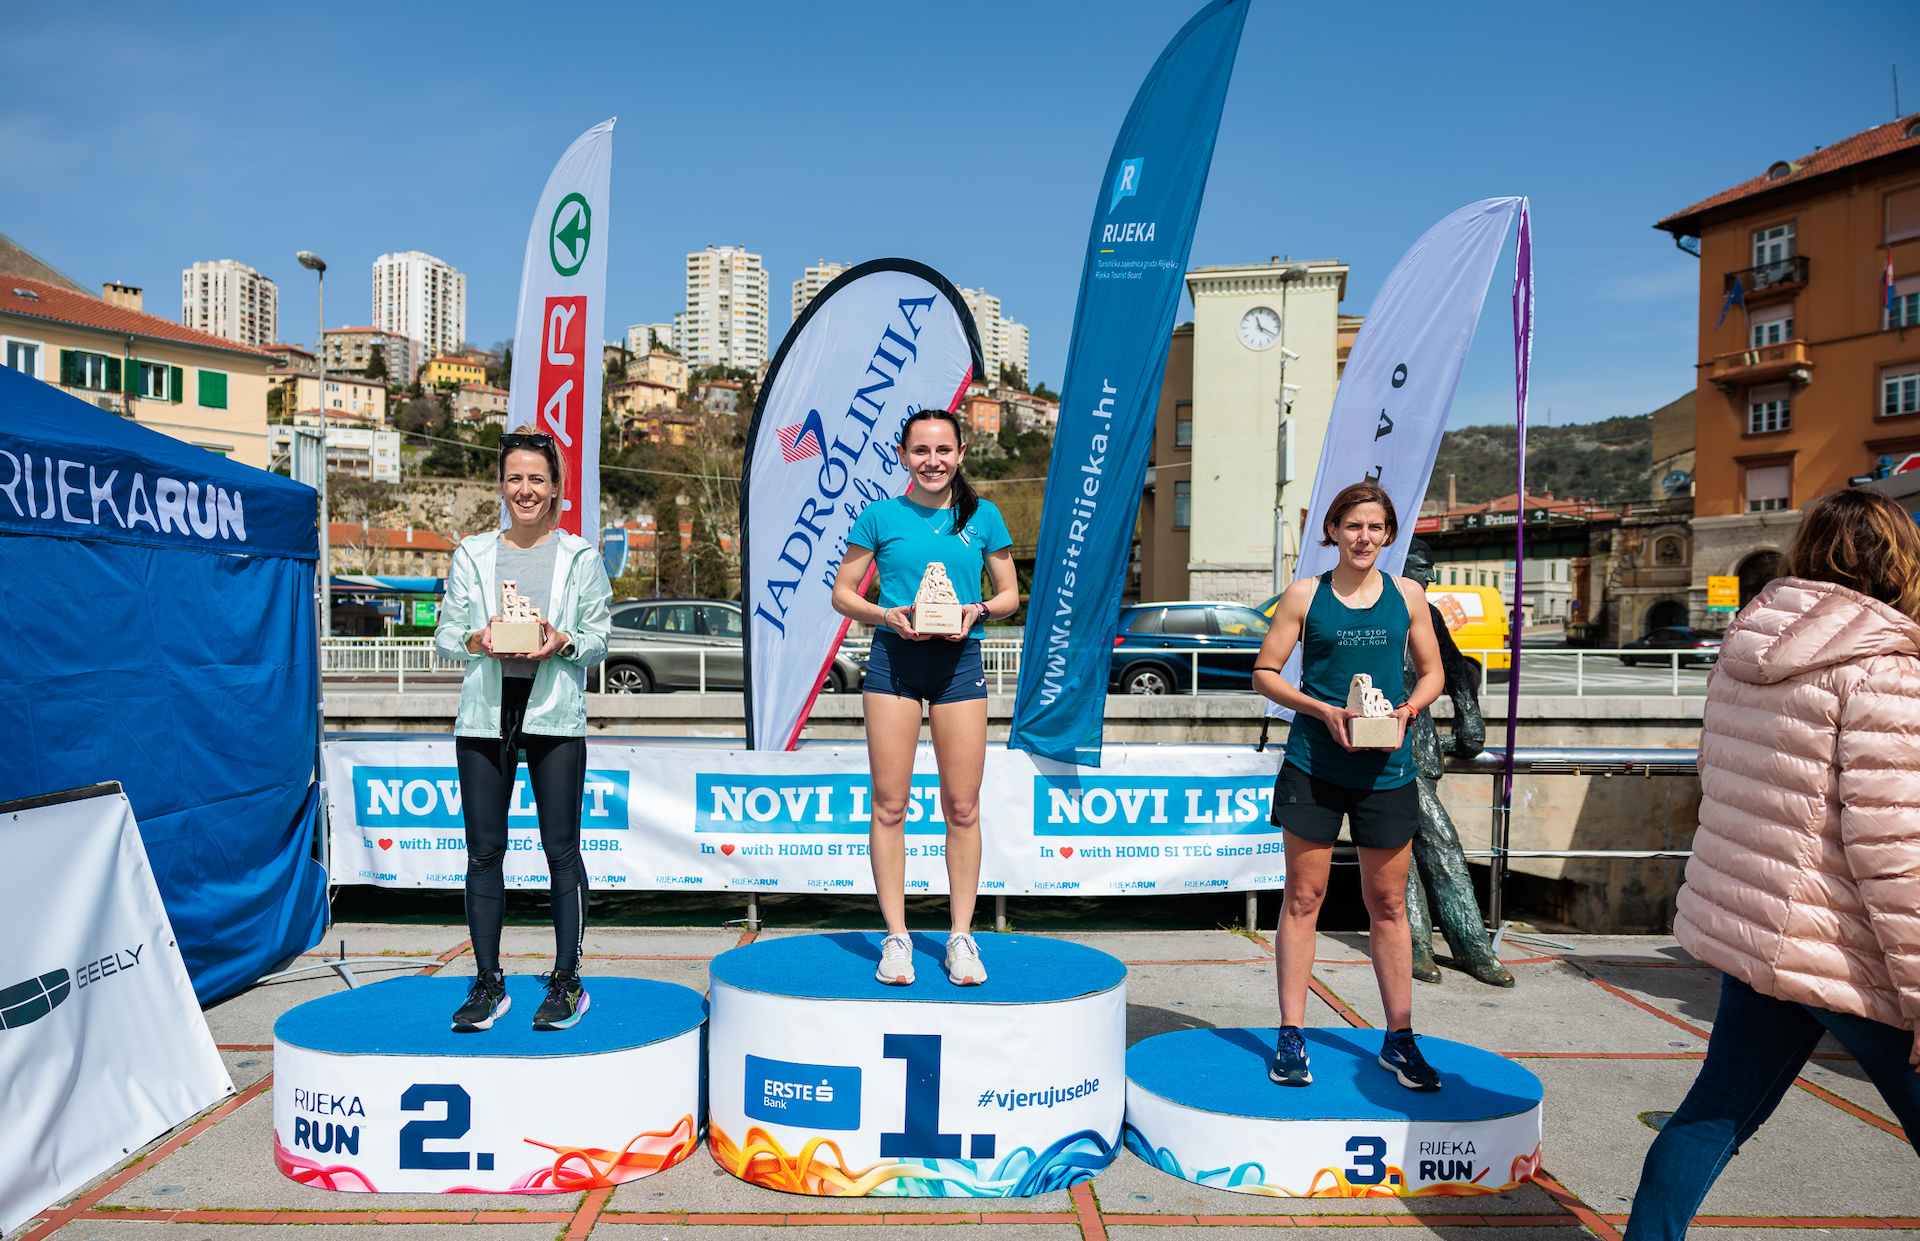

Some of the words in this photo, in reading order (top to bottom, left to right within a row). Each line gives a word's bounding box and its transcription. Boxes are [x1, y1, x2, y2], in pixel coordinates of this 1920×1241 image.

[1102, 222, 1156, 243] RIJEKA
[1110, 270, 1127, 279] Tourist
[1127, 271, 1143, 279] Board
[753, 292, 938, 640] JADROLINIJA
[1039, 378, 1118, 707] www.visitRijeka.hr
[1365, 629, 1387, 637] STOP
[367, 779, 463, 816] NOV
[710, 785, 834, 822] NOVI
[849, 786, 946, 823] LST
[1047, 788, 1169, 824] NOVI
[363, 836, 374, 849] In
[399, 838, 432, 850] with
[435, 838, 469, 850] HOM
[580, 839, 623, 851] 1998.
[700, 843, 716, 854] In
[741, 844, 774, 856] with
[778, 844, 823, 856] HOMO
[827, 844, 843, 856] SI
[1040, 846, 1055, 858] In
[1079, 846, 1112, 858] with
[1115, 846, 1160, 858] HOMO
[1164, 846, 1179, 858] SI
[1183, 842, 1212, 857] TEĆ
[1216, 845, 1253, 857] since
[426, 873, 467, 882] RIJEKARU
[655, 876, 703, 884] RIJEKARUN
[732, 877, 778, 886] RIJEKARUN
[807, 879, 854, 887] RIJEKARUN
[1034, 881, 1080, 889] RIJEKARUN
[1184, 879, 1229, 888] RIJEKARUN
[1254, 875, 1286, 884] RIJEKAR
[76, 943, 144, 989] GEELY
[764, 1079, 813, 1102] ERSTE
[880, 1033, 996, 1159] 1.
[977, 1075, 1100, 1112] #vjerujusebe
[294, 1087, 366, 1118] RIJEKA
[763, 1096, 788, 1111] Bank
[294, 1115, 360, 1156] RUN
[399, 1083, 495, 1171] 2.
[1419, 1140, 1477, 1155] RIJEKA
[1345, 1135, 1400, 1185] 3.
[1419, 1159, 1473, 1181] RUN
